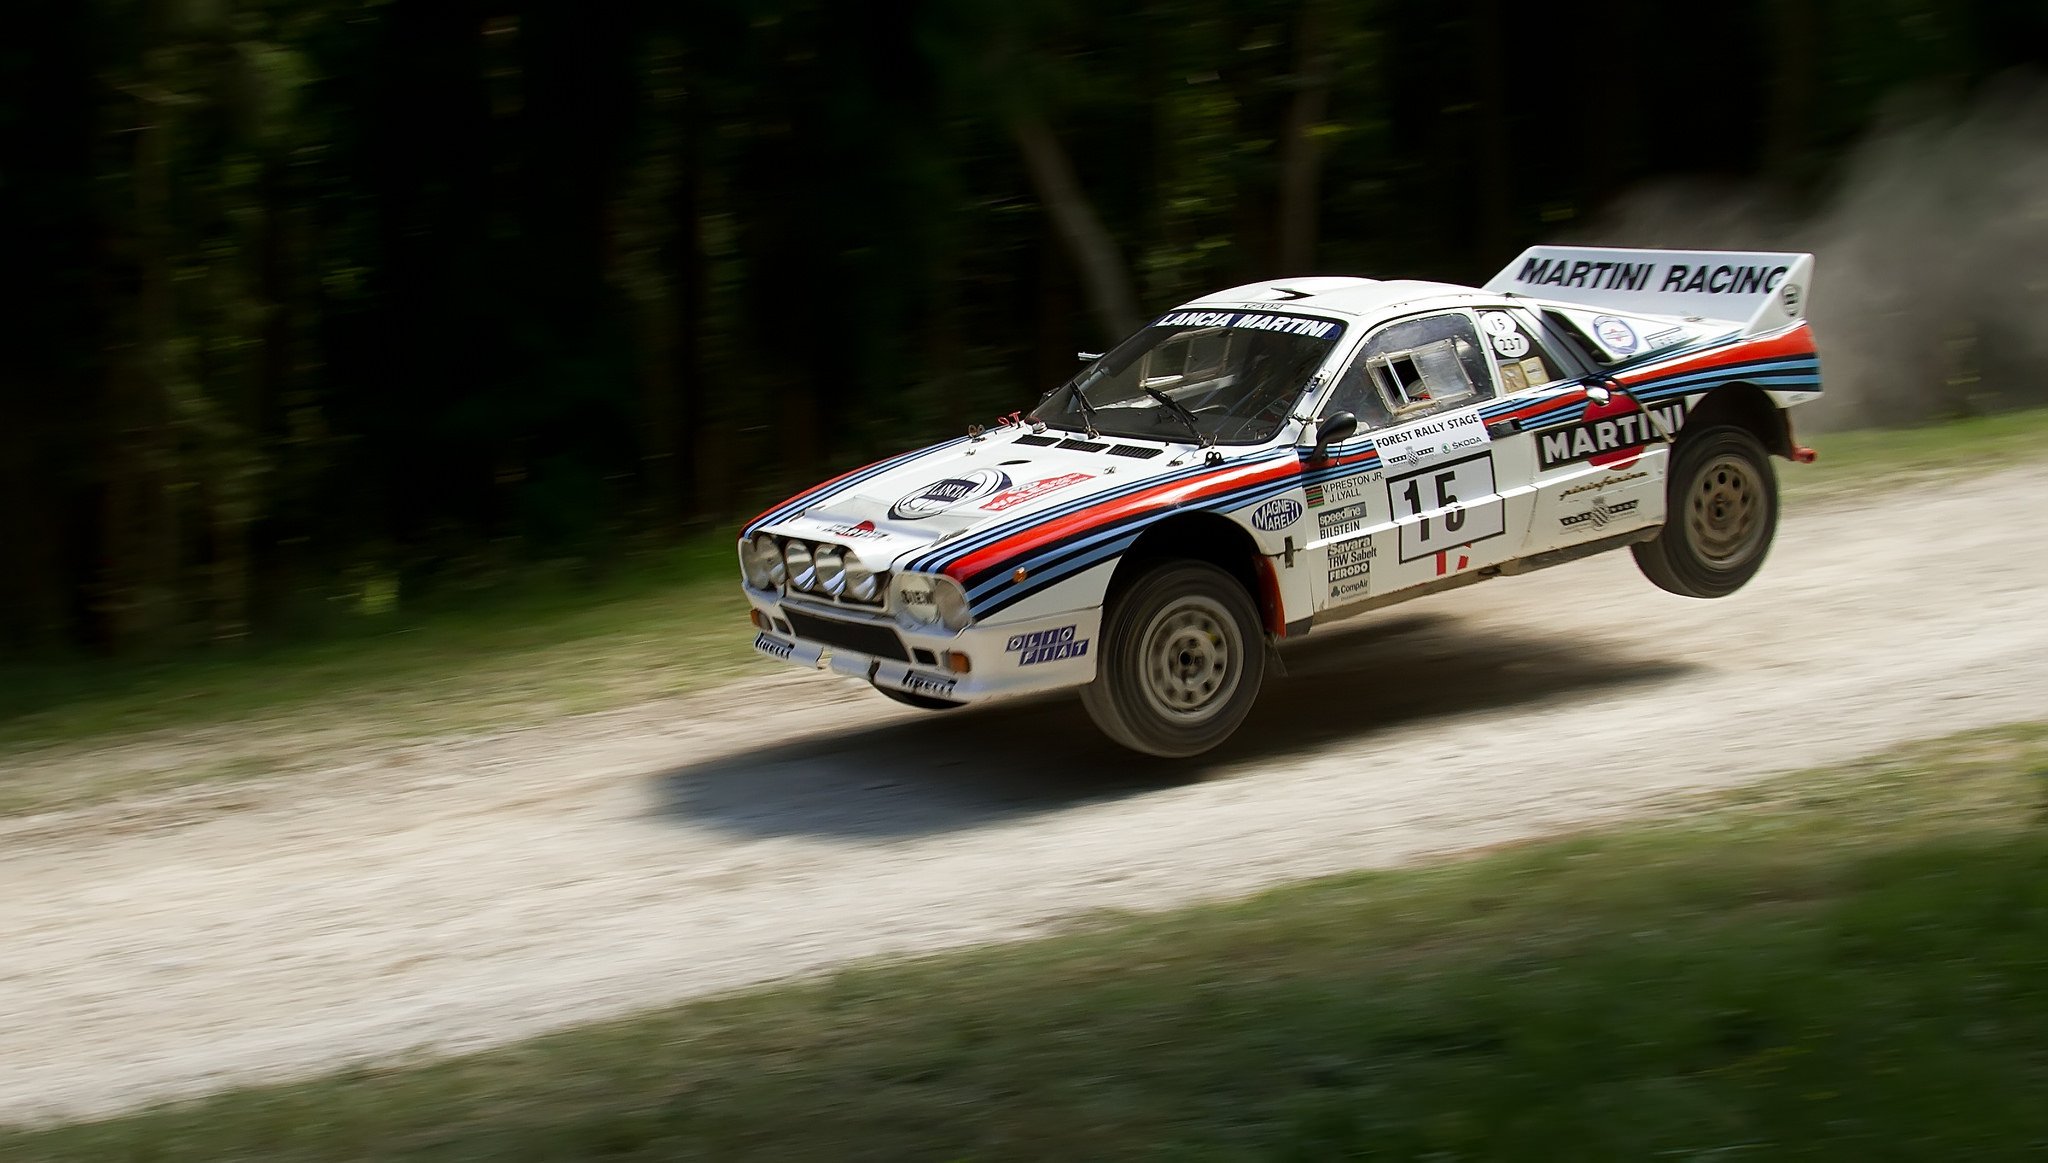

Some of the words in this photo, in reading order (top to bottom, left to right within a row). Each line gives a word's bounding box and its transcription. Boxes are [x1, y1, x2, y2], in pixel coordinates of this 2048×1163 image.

[1517, 257, 1653, 291] MARTINI
[1156, 312, 1230, 328] LANCIA
[1233, 314, 1335, 338] MARTINI
[1490, 318, 1505, 331] 15
[1499, 337, 1522, 351] 237
[1375, 431, 1413, 449] FOREST
[1415, 422, 1445, 438] RALLY
[1447, 414, 1479, 430] STAGE
[1452, 436, 1482, 450] ŠKODA
[1541, 403, 1684, 464] MARTINI
[1403, 471, 1466, 542] 15
[1320, 520, 1360, 539] BILSTEIN
[1328, 554, 1349, 569] TRW
[1330, 563, 1368, 581] FERODO
[1009, 626, 1073, 651] OLIO
[1022, 641, 1087, 665] FIAT
